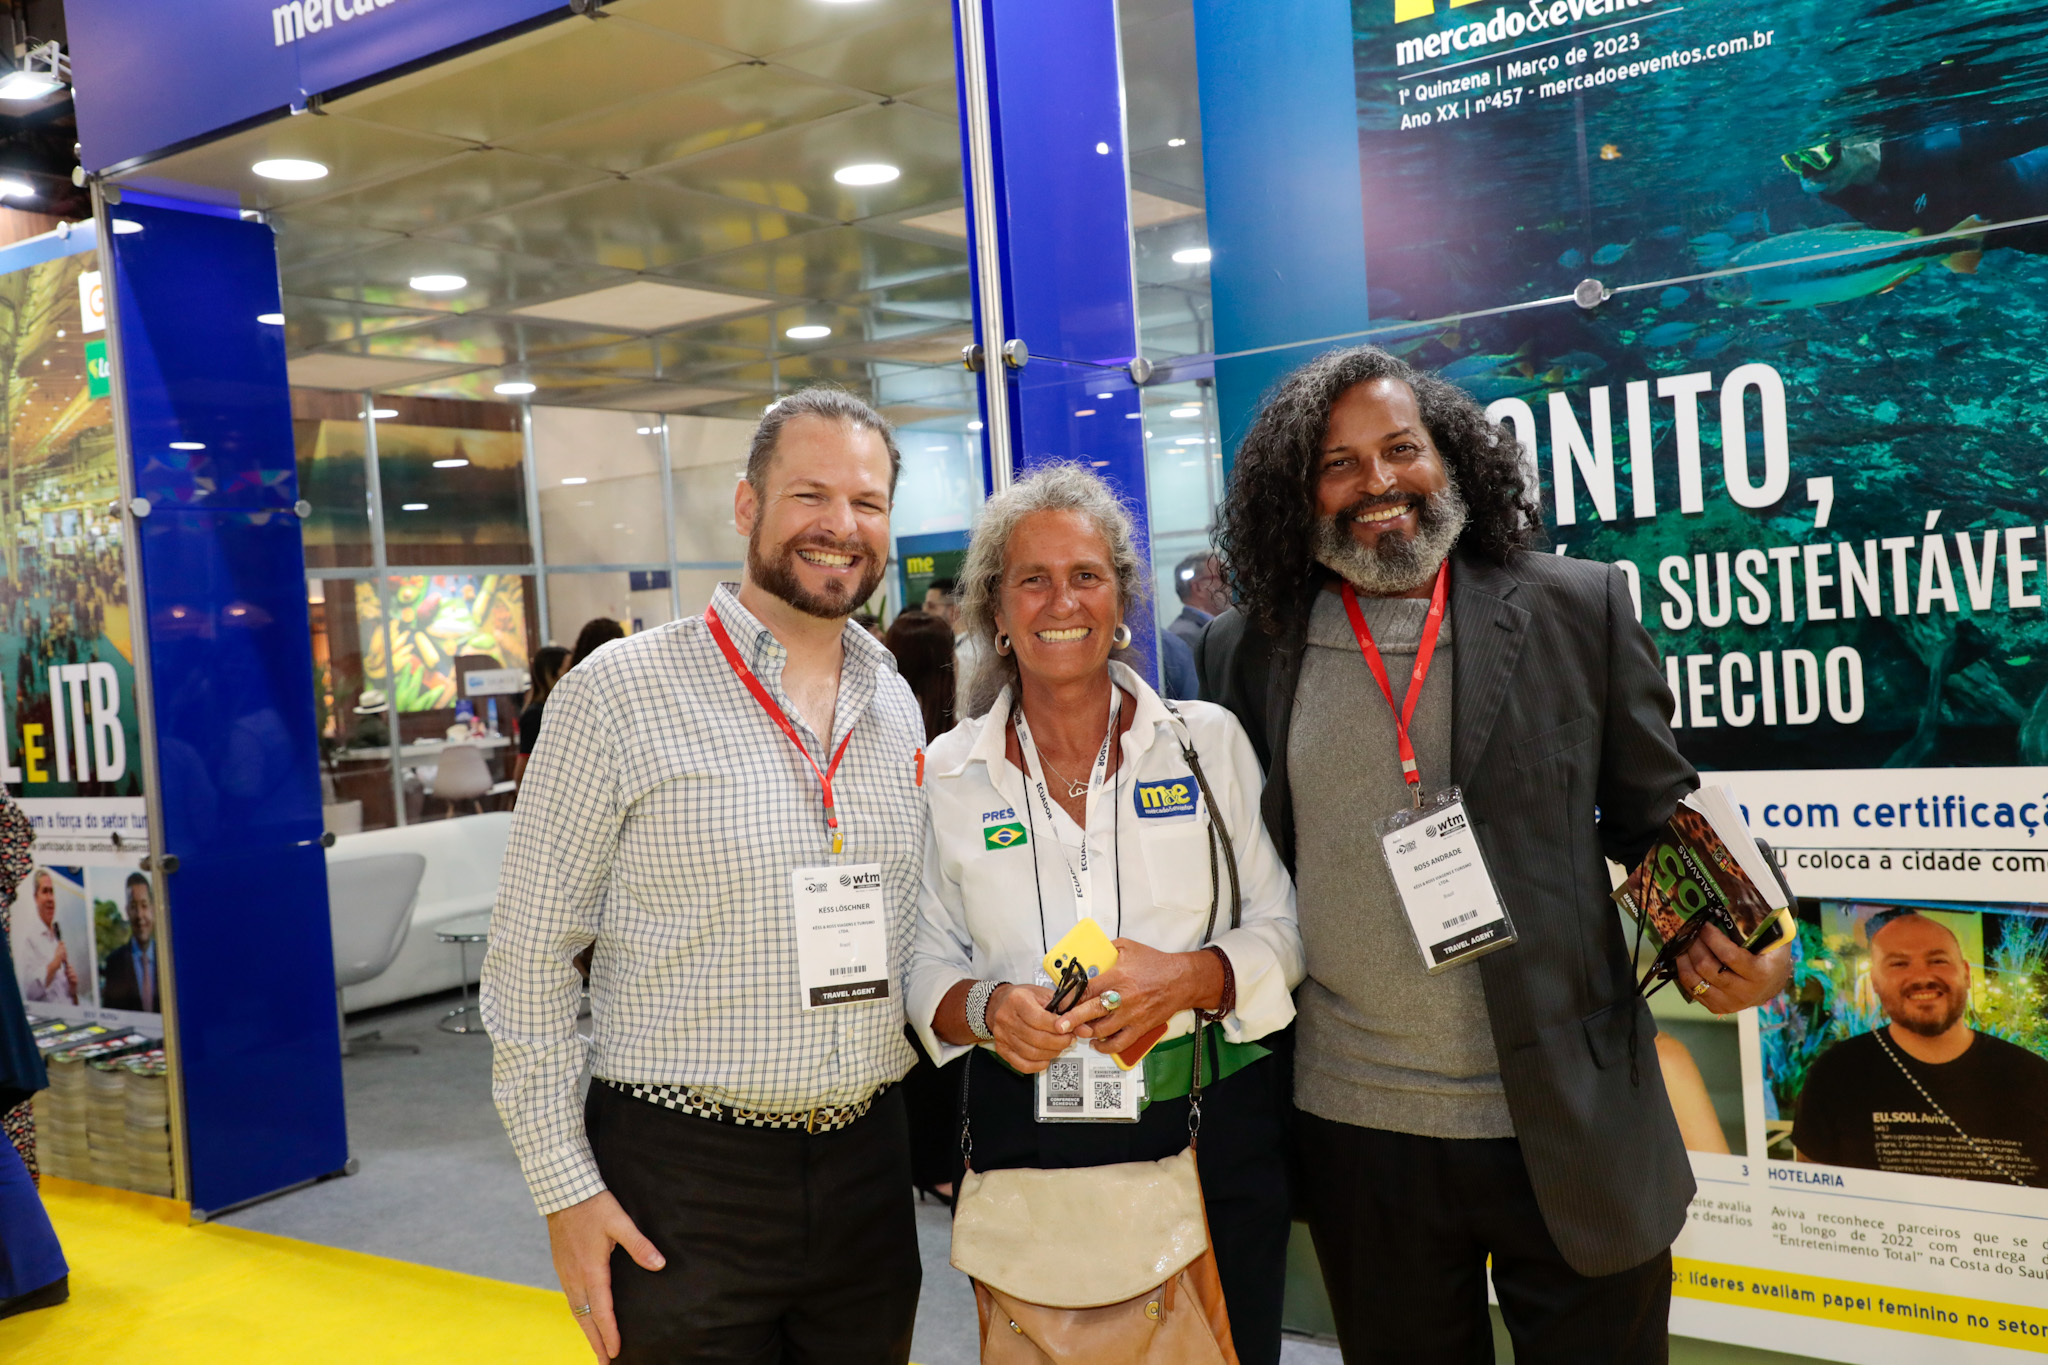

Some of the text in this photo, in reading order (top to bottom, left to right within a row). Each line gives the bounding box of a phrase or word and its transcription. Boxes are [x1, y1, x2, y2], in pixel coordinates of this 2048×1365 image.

[1400, 108, 1432, 130] Ano
[1436, 102, 1459, 123] XX
[1539, 29, 1775, 99] mercadoeeventos.com.br
[1415, 70, 1491, 101] Quinzena
[1507, 55, 1559, 81] Março
[1565, 46, 1588, 66] de
[1593, 32, 1640, 58] 2023
[1484, 362, 1834, 530] ONITO,
[1657, 509, 2048, 631] SUSTENTÁVE
[23, 723, 48, 783] E
[48, 661, 127, 783] ITB
[1036, 782, 1053, 820] ECUADOR
[1139, 783, 1191, 808] m&e
[1437, 813, 1465, 831] wtm
[1763, 803, 1839, 827] com
[1853, 792, 2048, 838] certificaç
[853, 872, 880, 884] wtm
[1413, 847, 1462, 872] ROSS ANDRADE
[1798, 850, 1869, 869] coloca
[1880, 855, 1892, 870] a
[1902, 851, 1981, 871] cidade
[1992, 855, 2048, 873] com
[1443, 930, 1495, 955] TRAVEL AGENT
[822, 987, 876, 1000] TRAVEL AGENT
[1742, 1165, 1845, 1188] 3 HOTELARIA
[1703, 1210, 1753, 1228] desafios
[1717, 1200, 1752, 1213] avalia
[1771, 1206, 1805, 1220] Aviva
[1817, 1211, 1885, 1230] reconhece
[1897, 1222, 1961, 1240] parceiros
[1973, 1231, 1999, 1245] que
[2012, 1237, 2028, 1248] se
[1771, 1221, 1787, 1232] ao
[1801, 1223, 1837, 1240] longo
[1851, 1229, 1866, 1241] de
[1881, 1233, 1914, 1248] 2022
[1929, 1241, 1958, 1253] com
[1973, 1246, 2026, 1264] entrega
[1772, 1233, 2048, 1281] “Entretenimento Total” na Costa do Sau
[1689, 1271, 1745, 1292] líderes
[1751, 1282, 1816, 1303] avaliam
[1823, 1292, 1871, 1311] papel
[1878, 1297, 1959, 1324] feminino
[1967, 1313, 1989, 1329] no
